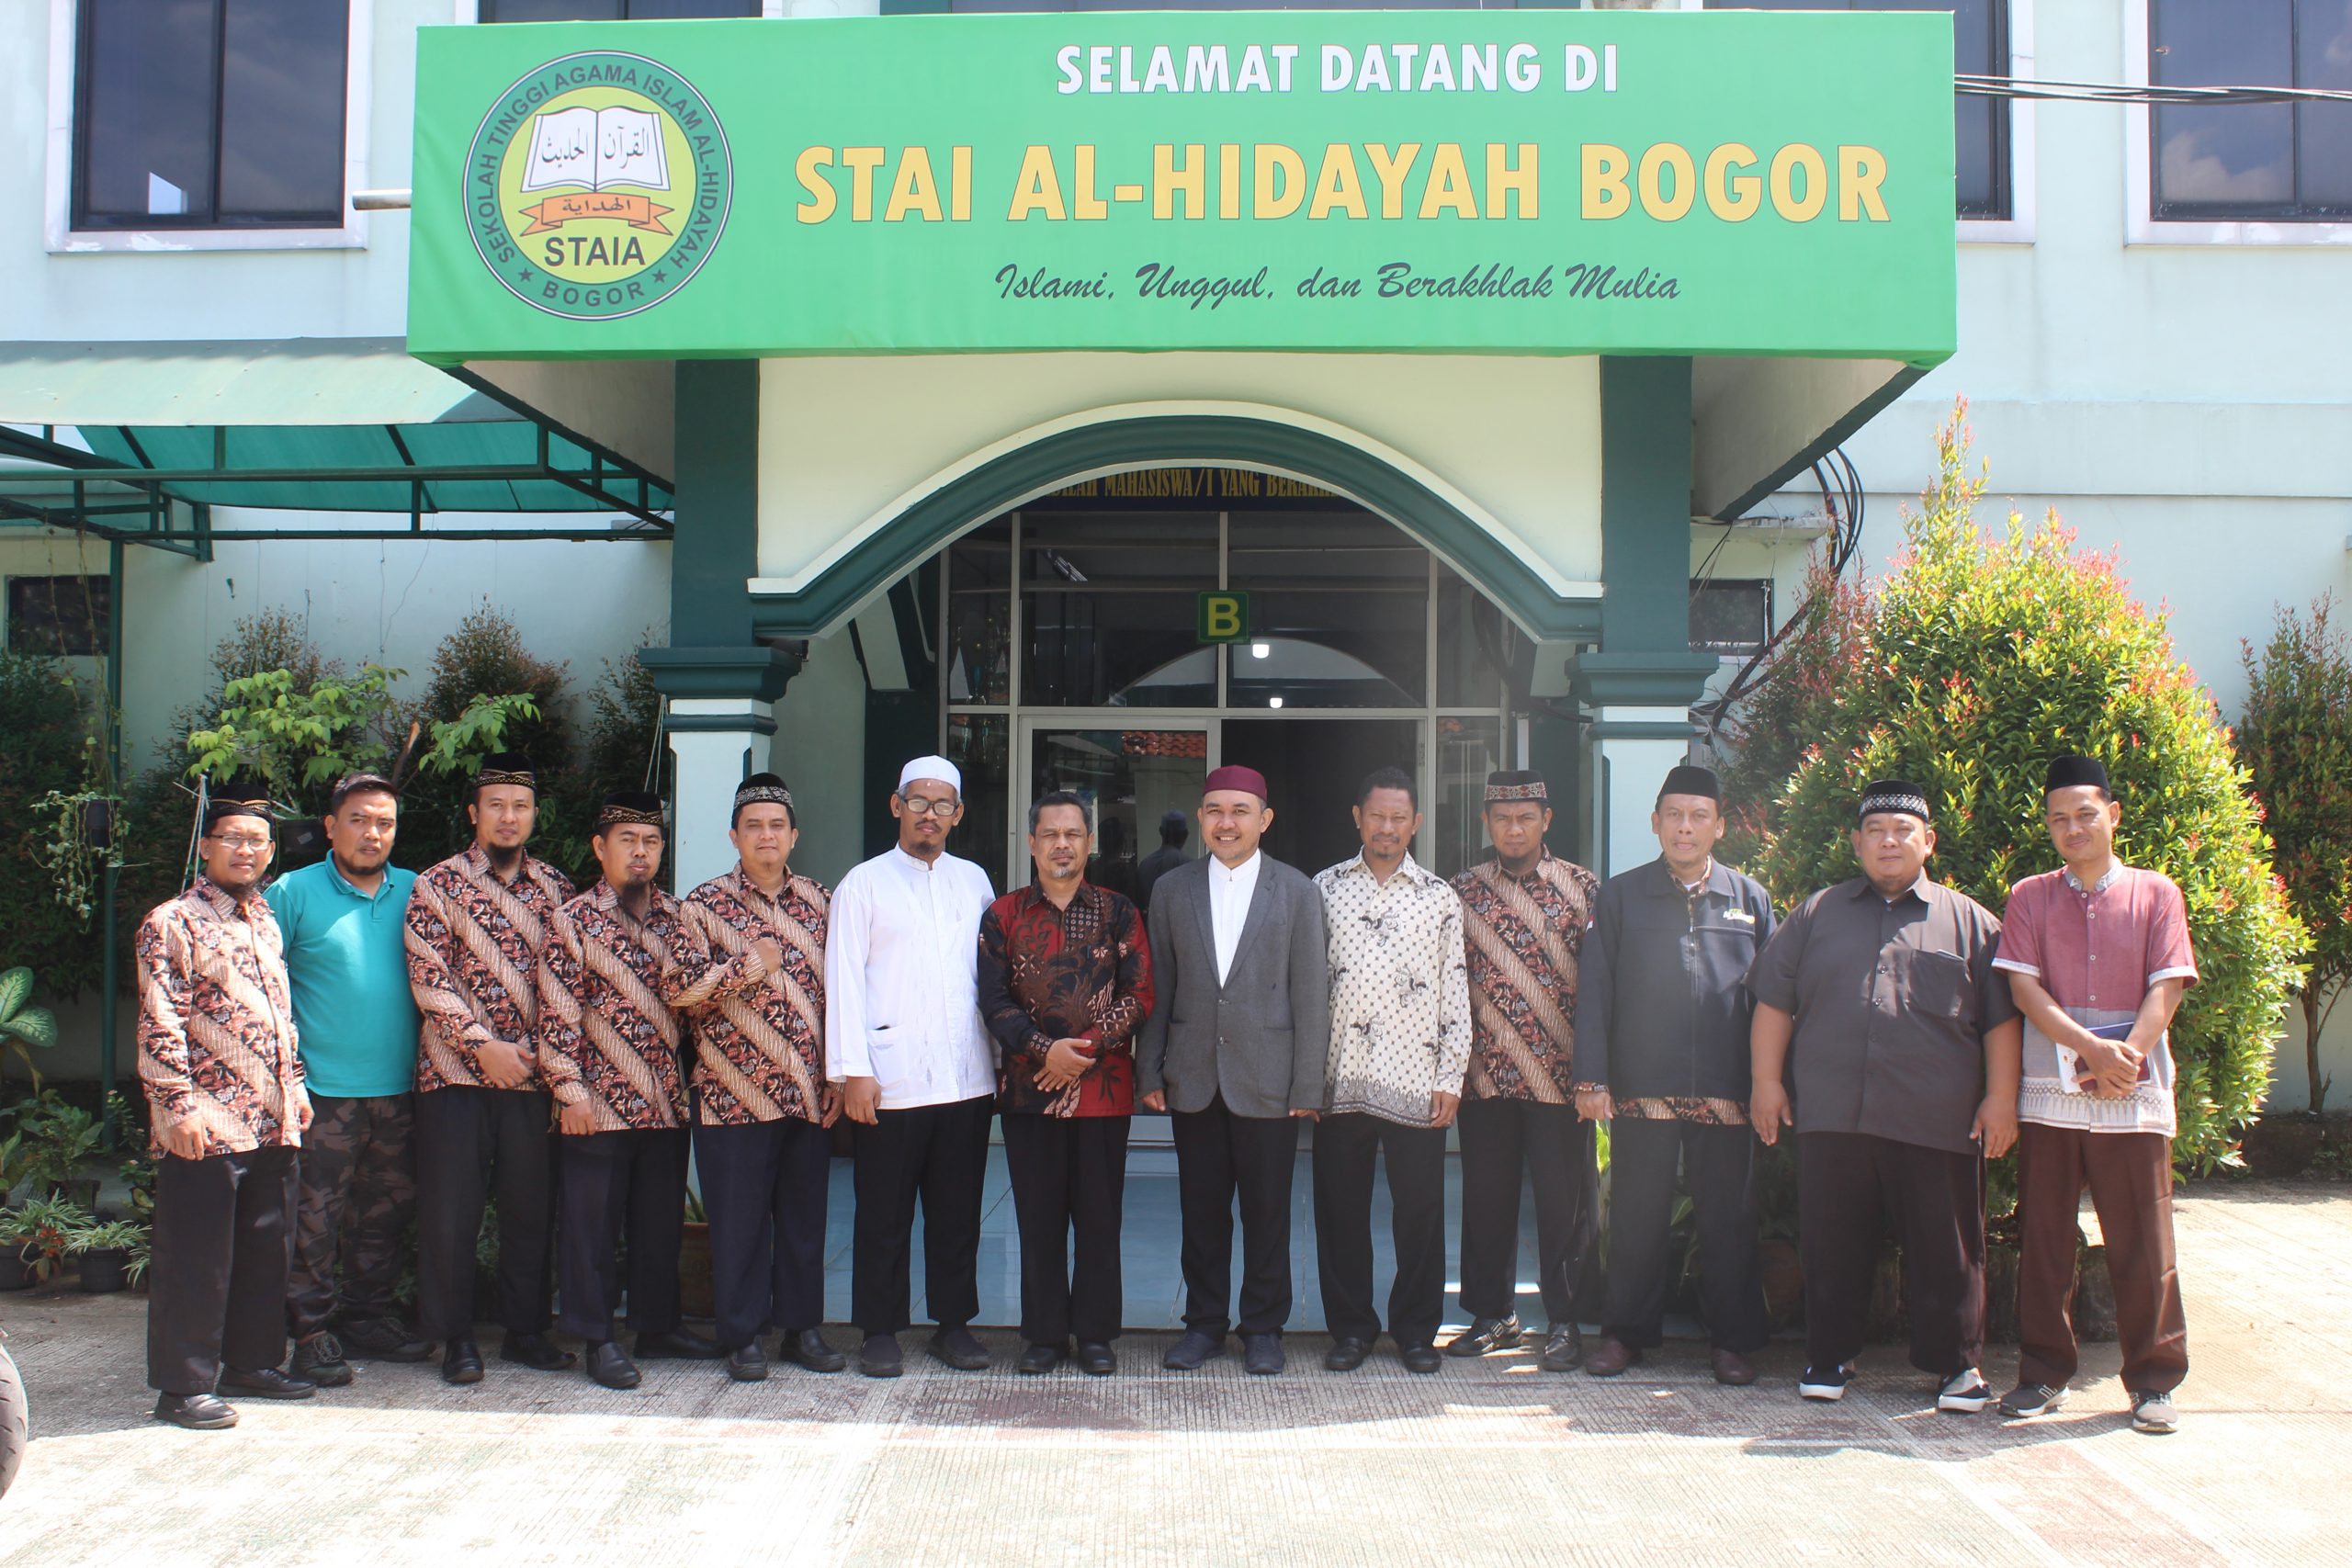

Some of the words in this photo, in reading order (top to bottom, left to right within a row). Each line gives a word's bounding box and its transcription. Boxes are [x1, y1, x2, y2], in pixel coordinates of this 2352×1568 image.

[553, 64, 638, 90] AGAMA
[1056, 44, 1300, 95] SELAMAT
[1320, 42, 1542, 93] DATANG
[1564, 43, 1618, 93] DI
[487, 81, 550, 150] TINGGI
[641, 73, 704, 130] ISLAM
[670, 133, 719, 269] AL-HIDAYAH
[795, 144, 973, 224] STAI
[1007, 143, 1539, 220] AL-HIDAYAH
[1580, 141, 1892, 223] BOGOR
[478, 153, 515, 264] SEKOLAH
[544, 235, 646, 267] STAIA
[541, 279, 646, 307] BOGOR
[995, 264, 1115, 300] Islami,
[1135, 262, 1275, 310] Unggul,
[1297, 265, 1363, 298] dan
[1377, 262, 1555, 299] Berakhlak
[1565, 263, 1682, 300] Mulia
[1219, 468, 1260, 497] YANG
[1206, 597, 1241, 636] B
